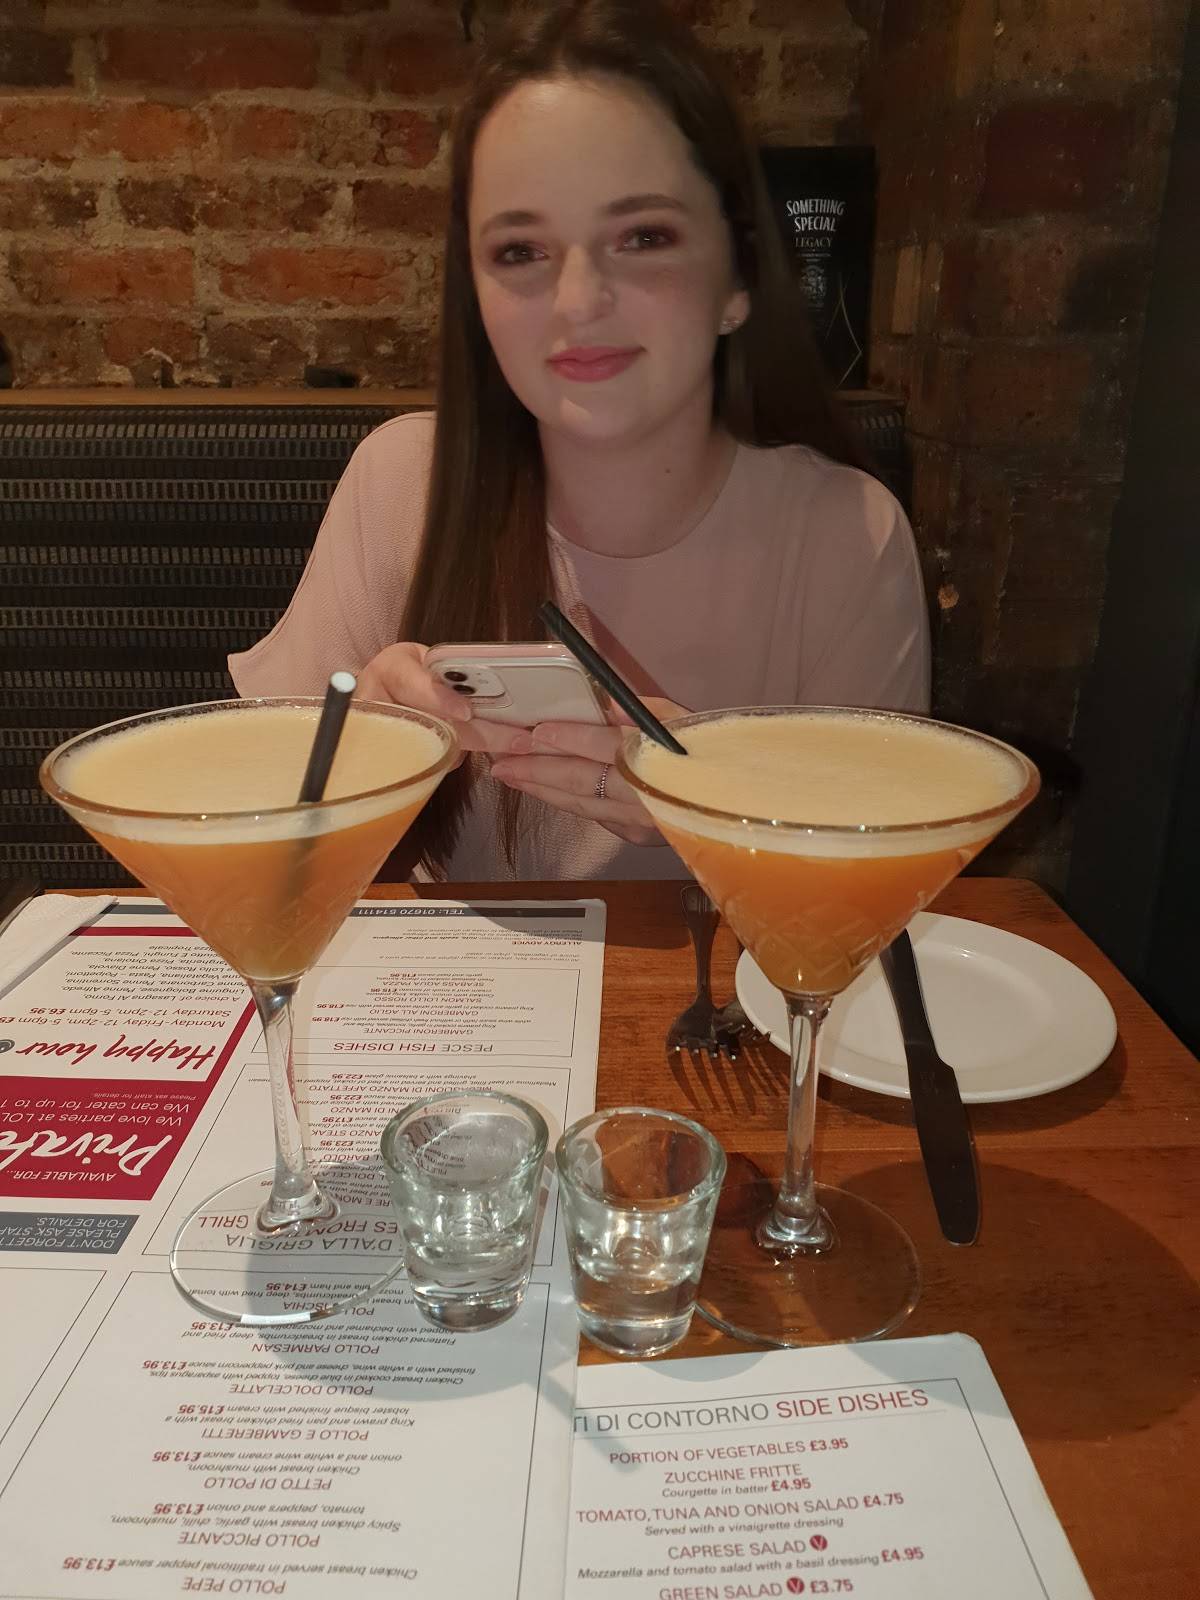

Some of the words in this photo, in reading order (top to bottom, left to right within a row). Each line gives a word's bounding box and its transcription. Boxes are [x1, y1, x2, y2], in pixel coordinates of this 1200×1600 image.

[786, 198, 845, 216] SOMETHING
[794, 216, 836, 232] SPECIAL
[795, 237, 832, 247] LEGACY
[29, 1007, 67, 1015] £6.95
[69, 1007, 112, 1016] 5-6pm
[172, 1008, 232, 1017] Saturday
[18, 1016, 62, 1025] 5-6pm
[122, 1018, 226, 1028] Monday-Friday
[105, 1034, 216, 1070] Happy
[333, 1042, 394, 1052] DISHES
[399, 1043, 436, 1052] FISH
[442, 1044, 493, 1052] PESCE
[16, 1042, 97, 1064] hour
[14, 1099, 31, 1109] to
[37, 1098, 55, 1108] up
[84, 1101, 126, 1110] cater
[131, 1102, 159, 1110] can
[163, 1103, 189, 1113] We
[37, 1113, 56, 1122] at
[58, 1113, 116, 1124] parties
[118, 1115, 152, 1126] love
[156, 1116, 182, 1127] We
[41, 1171, 117, 1182] AVAILABLE
[37, 1217, 94, 1227] DETAILS.
[97, 1219, 127, 1228] FOR
[197, 1215, 248, 1229] GRILL
[35, 1227, 65, 1237] ASK
[66, 1228, 121, 1238] PLEASE
[6, 1237, 65, 1247] FORGET
[67, 1239, 114, 1248] DON'T
[226, 1235, 313, 1251] GRIGLIA
[251, 1341, 331, 1353] PARMESAN
[334, 1344, 380, 1354] POLLO
[229, 1383, 322, 1395] DOLCELATTE
[327, 1384, 374, 1396] POLLO
[597, 1414, 619, 1432] DI
[628, 1403, 769, 1429] CONTORNO
[776, 1397, 832, 1419] SIDE
[838, 1389, 929, 1413] DISHES
[201, 1427, 302, 1440] GAMBERETTI
[306, 1429, 315, 1440] E
[319, 1429, 370, 1441] POLLO
[609, 1450, 679, 1465] PORTION
[706, 1440, 806, 1460] VEGETABLES
[809, 1437, 849, 1452] £3.95
[251, 1465, 276, 1474] with
[278, 1465, 314, 1474] breast
[316, 1465, 360, 1476] Chicken
[664, 1468, 746, 1484] ZUCCHINE
[749, 1464, 804, 1479] FRITTE
[204, 1477, 257, 1490] POLLO
[260, 1477, 277, 1490] DI
[280, 1478, 333, 1490] PETTO
[662, 1487, 718, 1498] Courgette
[721, 1486, 732, 1495] in
[735, 1485, 768, 1494] batter
[770, 1478, 812, 1492] £4.95
[153, 1503, 204, 1516] £13.95
[206, 1503, 240, 1513] onion
[241, 1504, 266, 1514] and
[268, 1504, 318, 1513] peppers
[652, 1506, 700, 1520] TUNA
[704, 1505, 740, 1518] AND
[744, 1501, 800, 1517] ONION
[803, 1496, 859, 1513] SALAD
[862, 1492, 904, 1508] £4.75
[252, 1519, 278, 1529] with
[280, 1519, 318, 1529] breast
[321, 1519, 366, 1530] chicken
[366, 1519, 401, 1533] Spicy
[644, 1526, 687, 1536] Served
[690, 1524, 715, 1535] with
[718, 1525, 725, 1533] a
[728, 1521, 791, 1534] vinaigrette
[793, 1517, 844, 1529] dressing
[178, 1531, 262, 1547] PICCANTE
[265, 1534, 320, 1548] POLLO
[668, 1543, 745, 1560] CAPRESE
[749, 1539, 806, 1556] SALAD
[62, 1556, 116, 1571] £13.95
[118, 1559, 154, 1568] sauce
[156, 1559, 200, 1571] pepper
[200, 1562, 266, 1573] traditional
[577, 1567, 643, 1579] Mozzarella
[646, 1565, 670, 1577] and
[673, 1565, 717, 1576] tomato
[720, 1562, 752, 1573] salad
[755, 1560, 782, 1571] with
[785, 1561, 793, 1570] a
[796, 1557, 824, 1569] basil
[827, 1555, 880, 1568] dressing
[881, 1546, 925, 1563] £4.95
[268, 1564, 280, 1574] in
[281, 1564, 325, 1575] served
[326, 1565, 366, 1576] breast
[369, 1567, 418, 1580] Chicken
[181, 1577, 226, 1592] PEPE
[229, 1579, 286, 1594] POLLO
[725, 1581, 783, 1598] SALAD
[810, 1578, 854, 1594] £3.75
